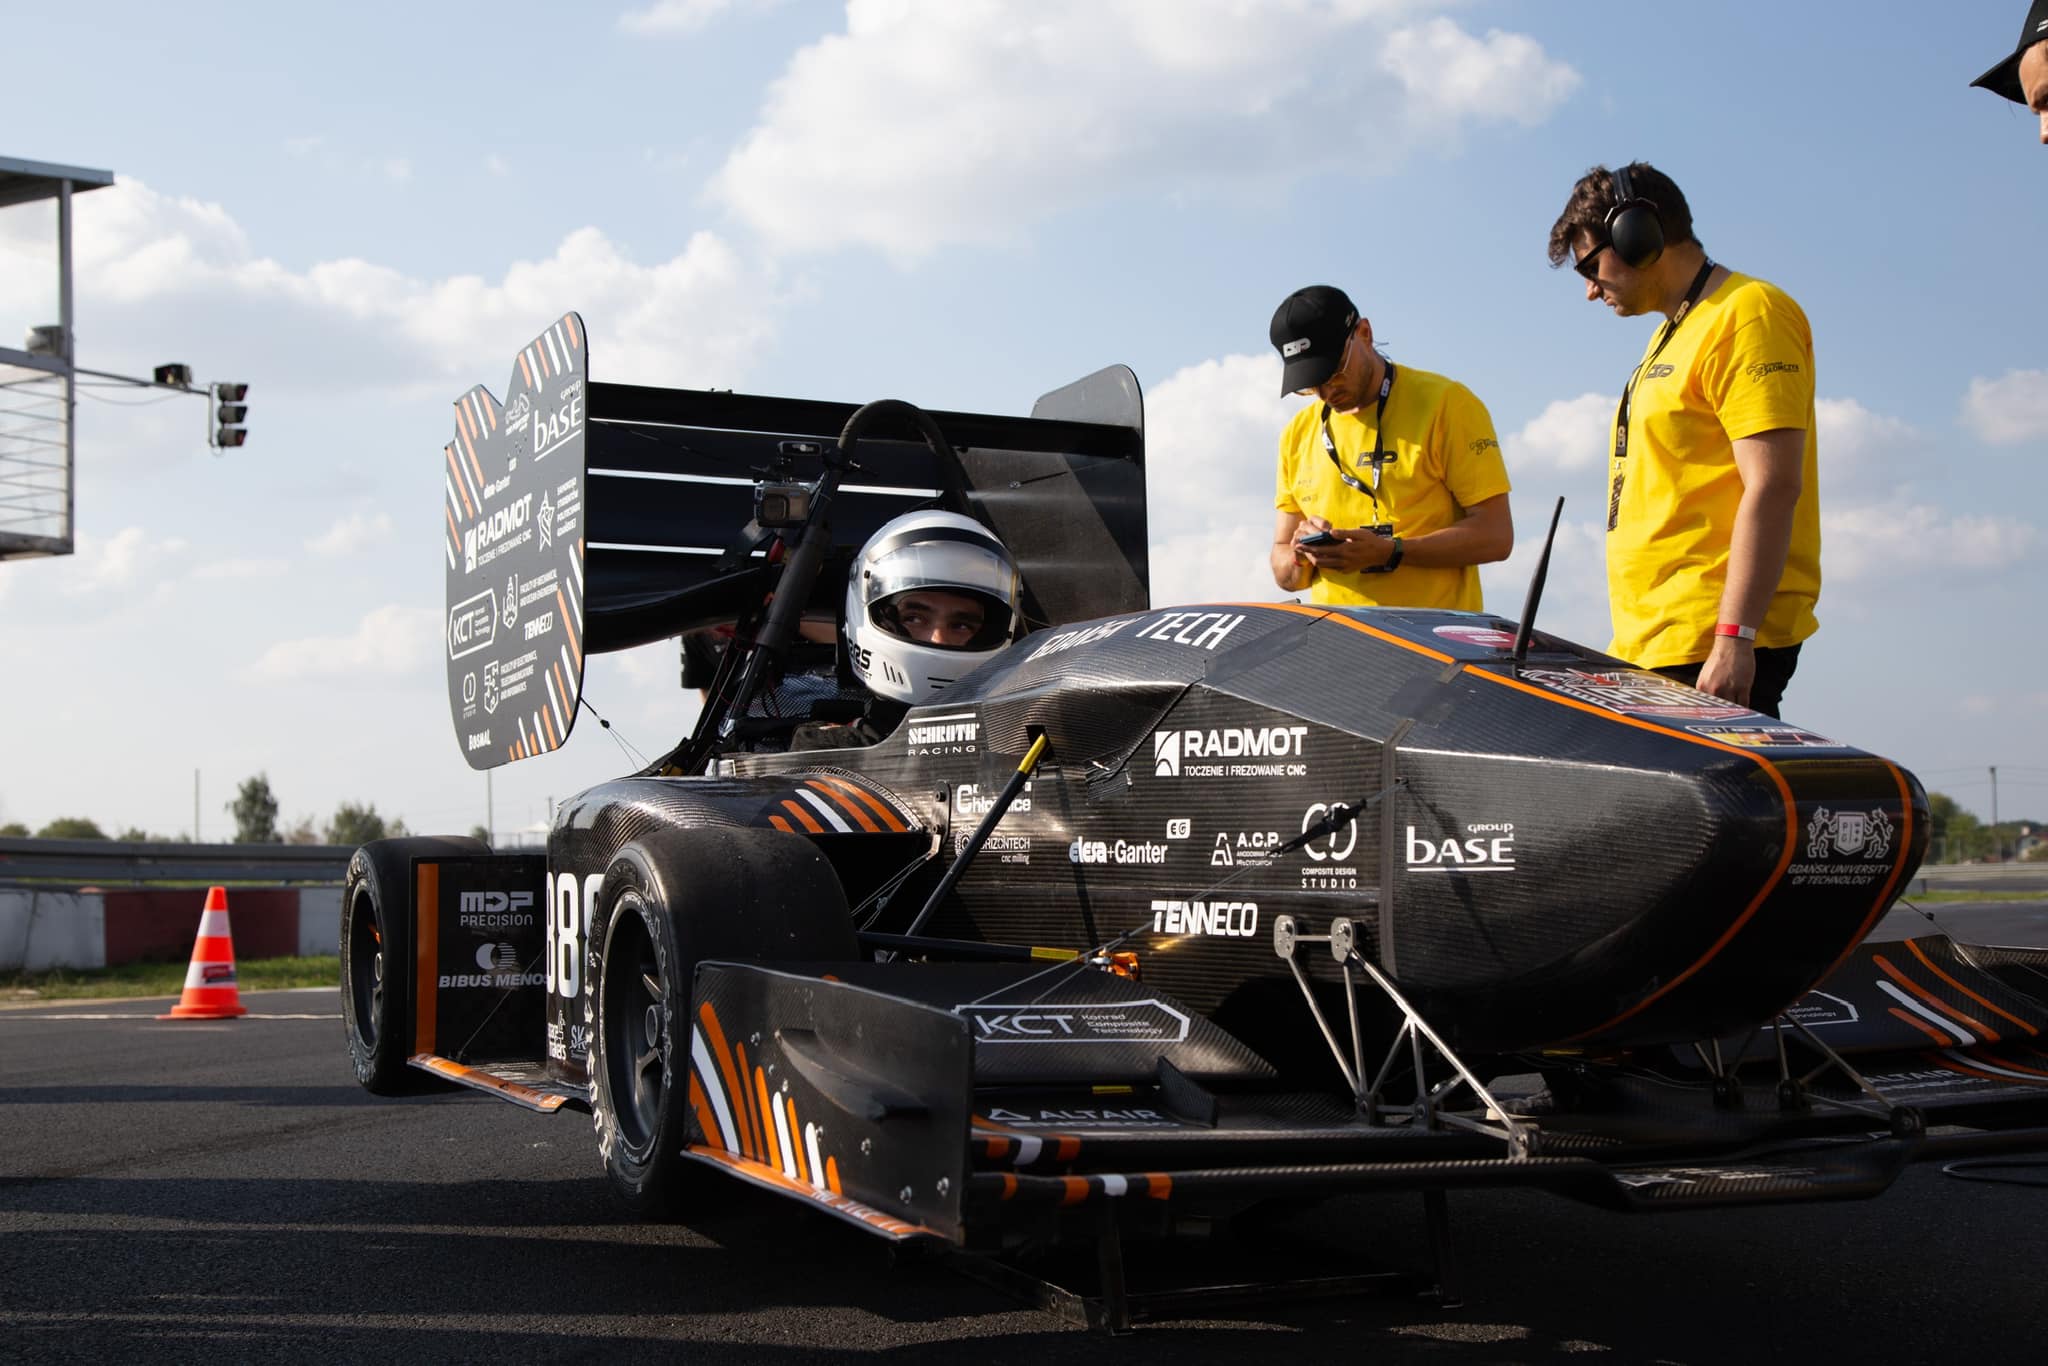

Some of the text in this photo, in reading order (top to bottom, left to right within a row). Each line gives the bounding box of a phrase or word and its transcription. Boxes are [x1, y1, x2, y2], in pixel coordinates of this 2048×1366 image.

[478, 493, 532, 550] RADMOT
[453, 611, 474, 646] KCT
[1135, 612, 1247, 650] TECH
[908, 722, 978, 745] SCHROTH
[1184, 726, 1308, 758] RADMOT
[908, 745, 976, 757] RACING
[1184, 764, 1307, 777] TOCZENIE I FREZOWANIE CNC
[1236, 831, 1283, 848] A.C.P.
[1302, 867, 1357, 876] COMPOSITE DESIGN
[1788, 862, 1893, 874] GDAŃSK UNIVERSITY
[1302, 878, 1357, 889] STUDIO
[1792, 875, 1875, 885] OF TECHNOLOGY
[460, 891, 534, 912] MDP
[460, 914, 533, 927] PRECISION
[1151, 900, 1259, 937] TENNECO
[438, 973, 546, 988] BIBUS MENO
[974, 1015, 1073, 1034] KCT
[1092, 1027, 1163, 1035] Technology
[1039, 1109, 1164, 1120] ALTAIR
